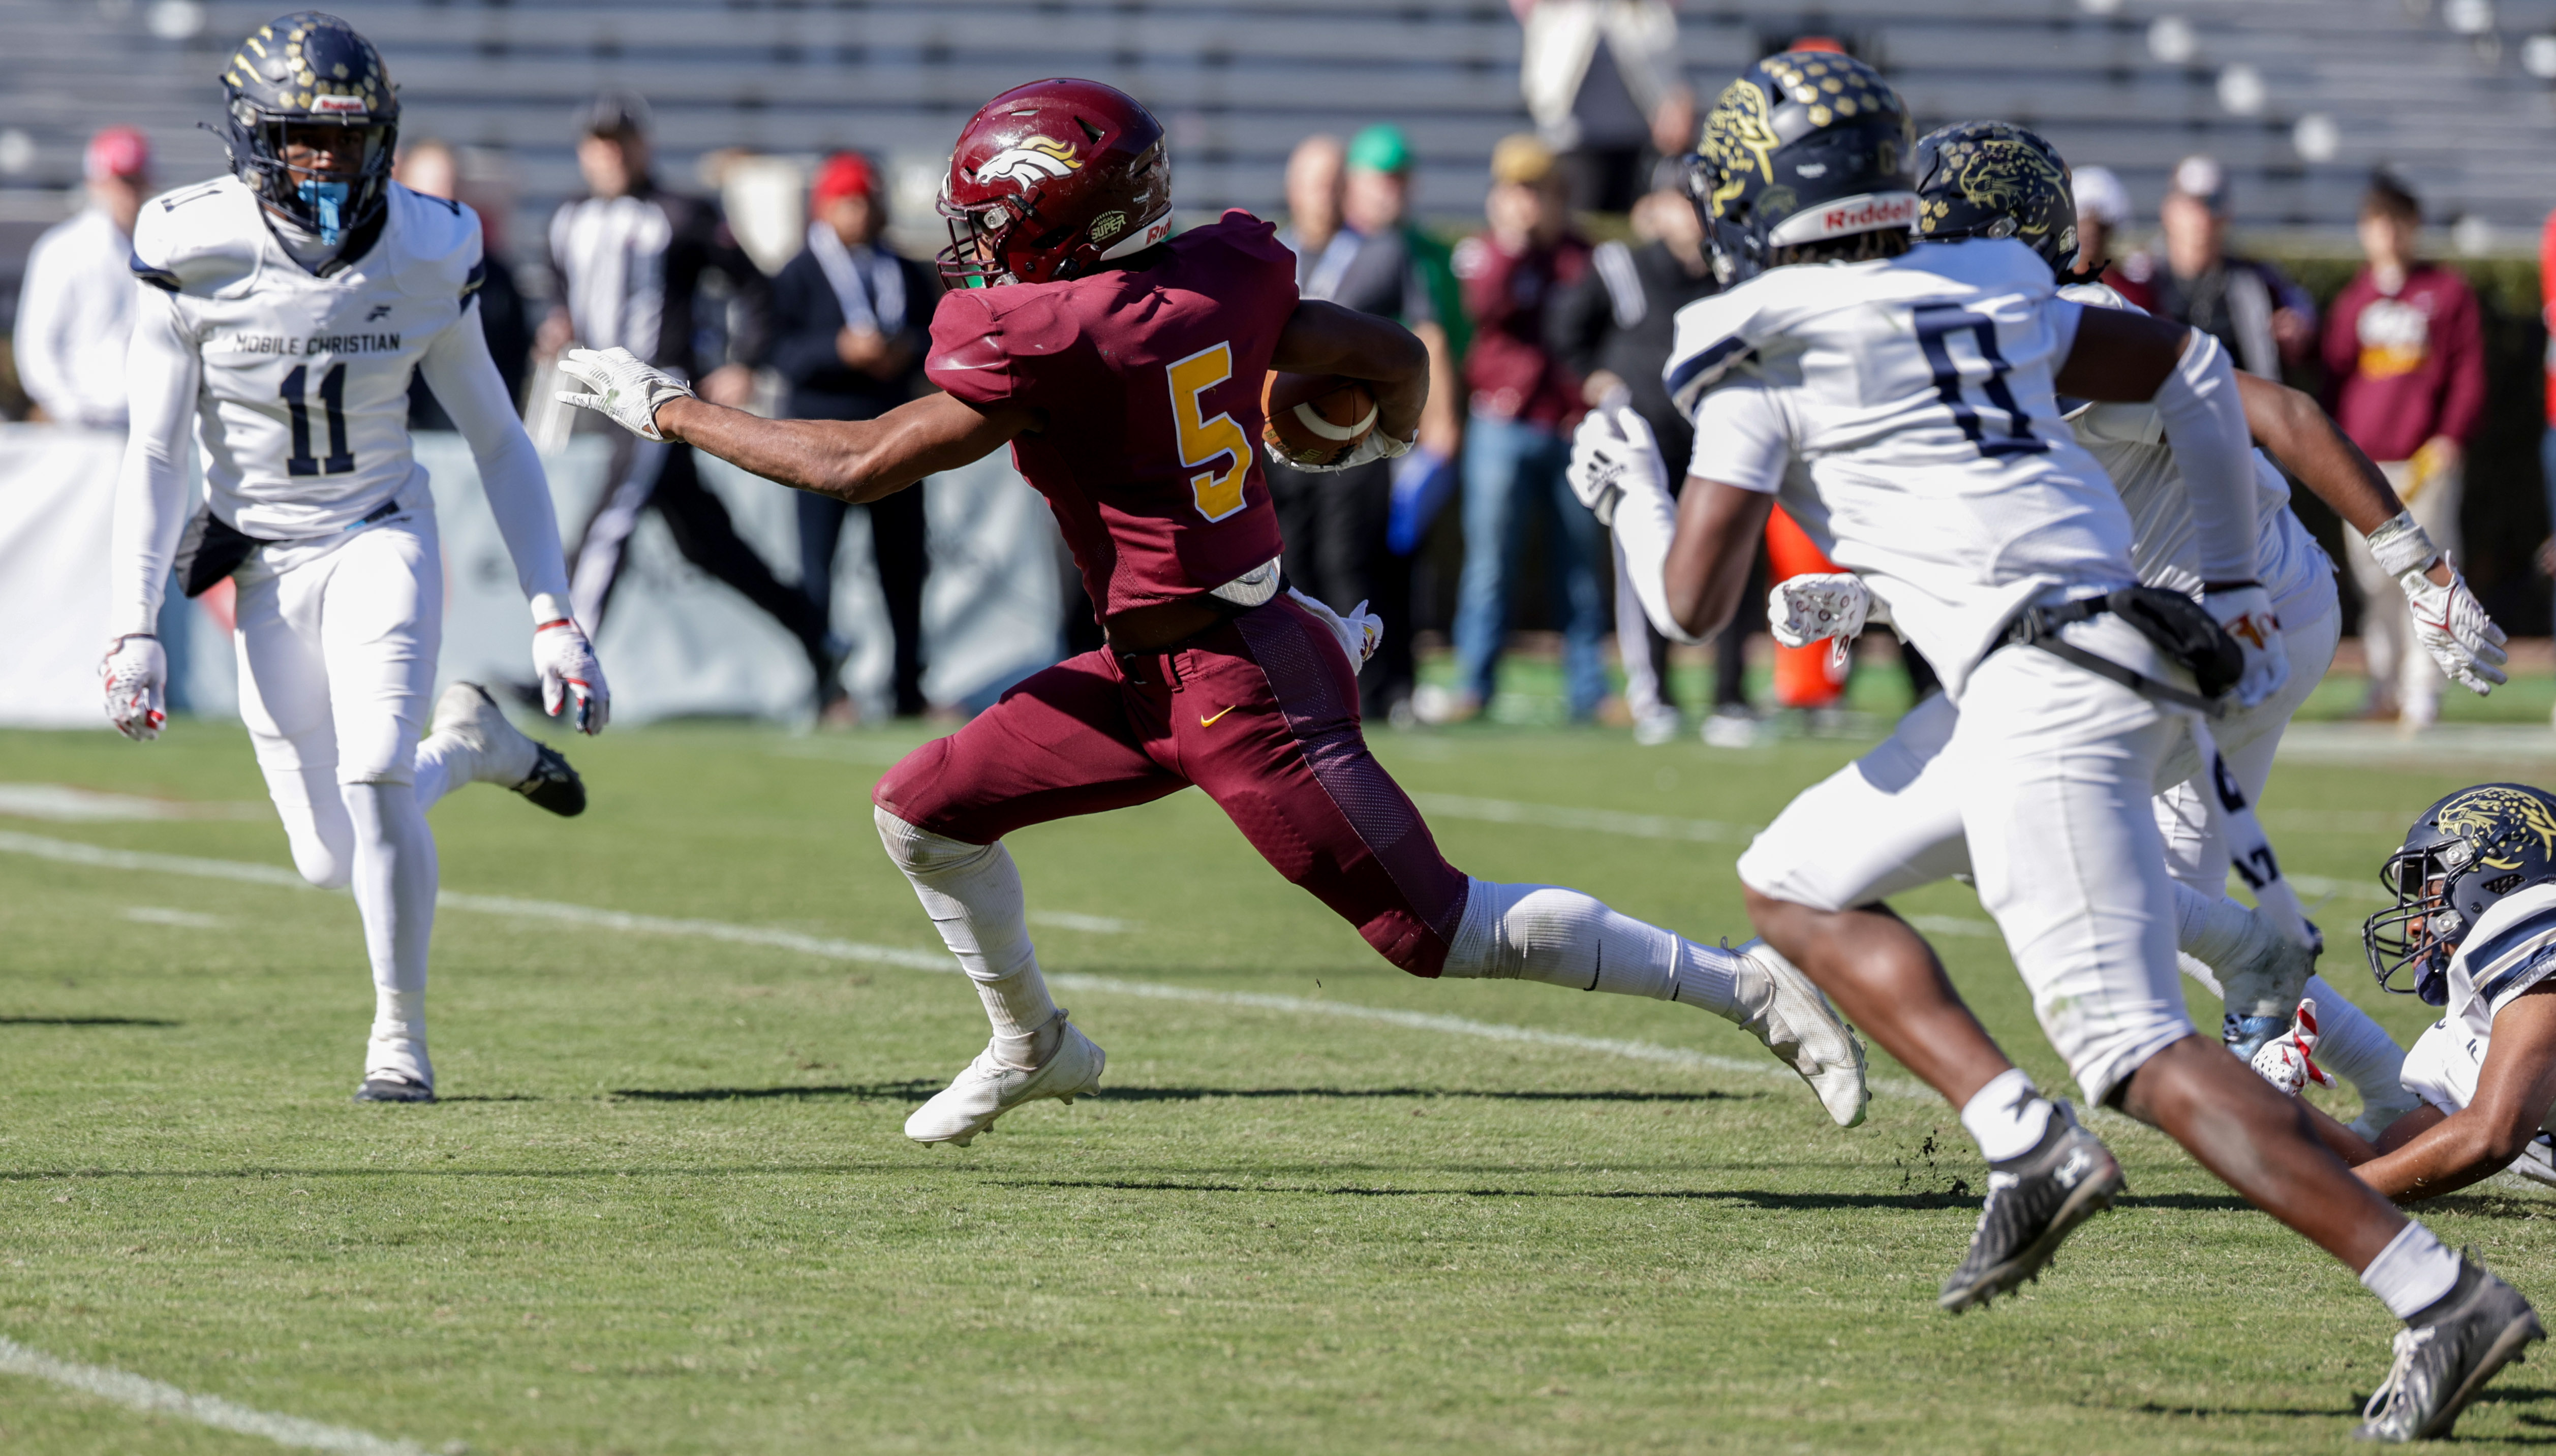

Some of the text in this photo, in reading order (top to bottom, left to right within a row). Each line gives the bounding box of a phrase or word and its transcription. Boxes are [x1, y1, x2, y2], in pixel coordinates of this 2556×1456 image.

[1825, 198, 1914, 230] Riddell
[233, 333, 399, 355] MOBILE CHRISTIAN
[280, 362, 355, 476] 11
[1166, 340, 1253, 523] 5
